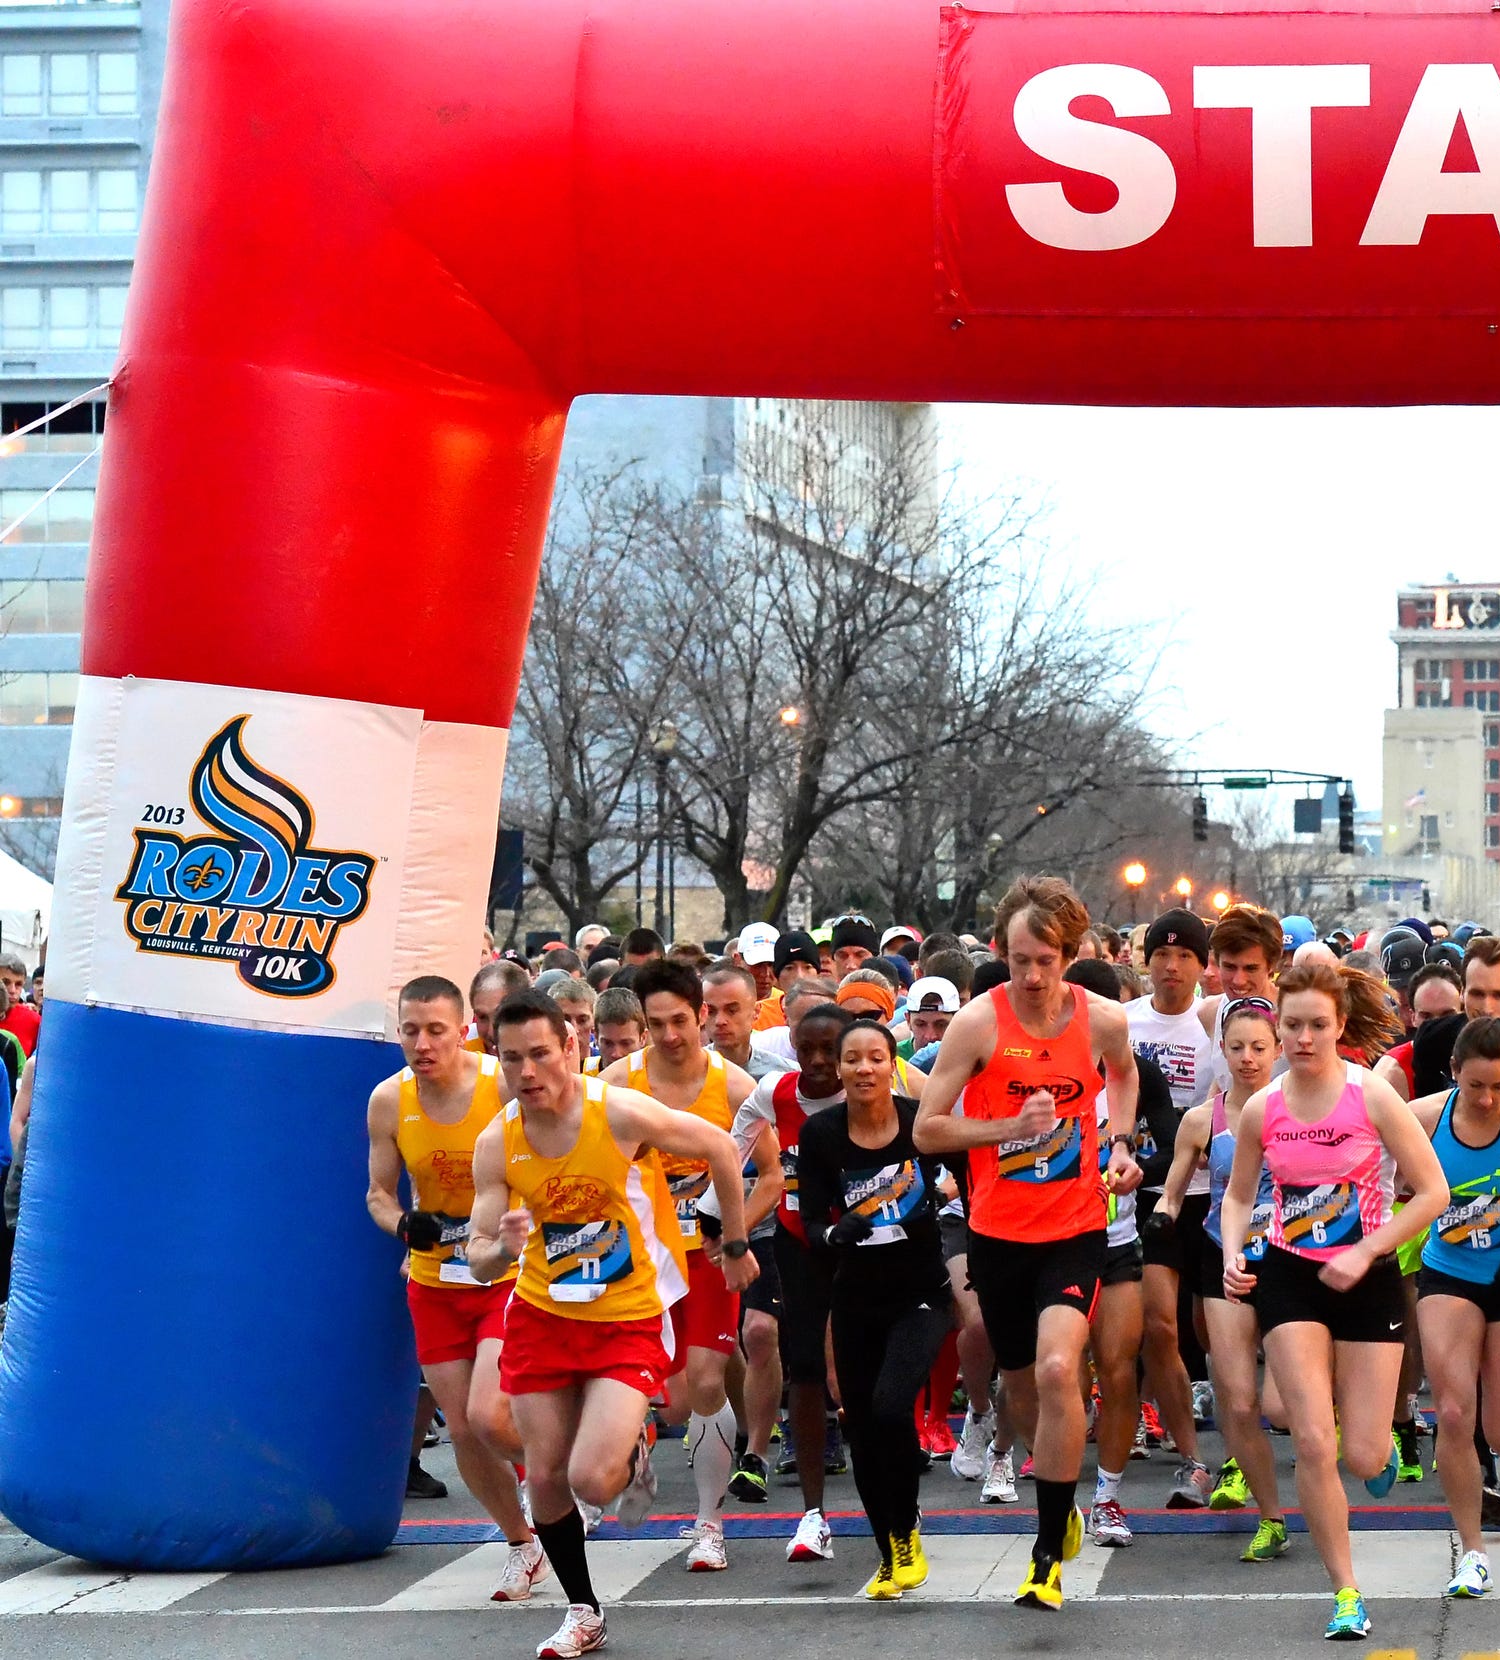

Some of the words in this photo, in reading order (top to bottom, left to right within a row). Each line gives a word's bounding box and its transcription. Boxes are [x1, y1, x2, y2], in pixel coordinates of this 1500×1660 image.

[141, 804, 185, 825] 2013
[127, 838, 368, 917] RODES
[146, 937, 198, 953] LOUISVILLE,
[201, 944, 252, 958] KENTUCKY
[252, 955, 308, 981] 10K
[1275, 1128, 1335, 1142] saucony
[1034, 1156, 1049, 1179] 5
[878, 1199, 901, 1221] 11
[1285, 1194, 1309, 1206] 2013
[1311, 1221, 1327, 1244] 6
[1467, 1228, 1492, 1249] 15
[1250, 1236, 1264, 1256] 3
